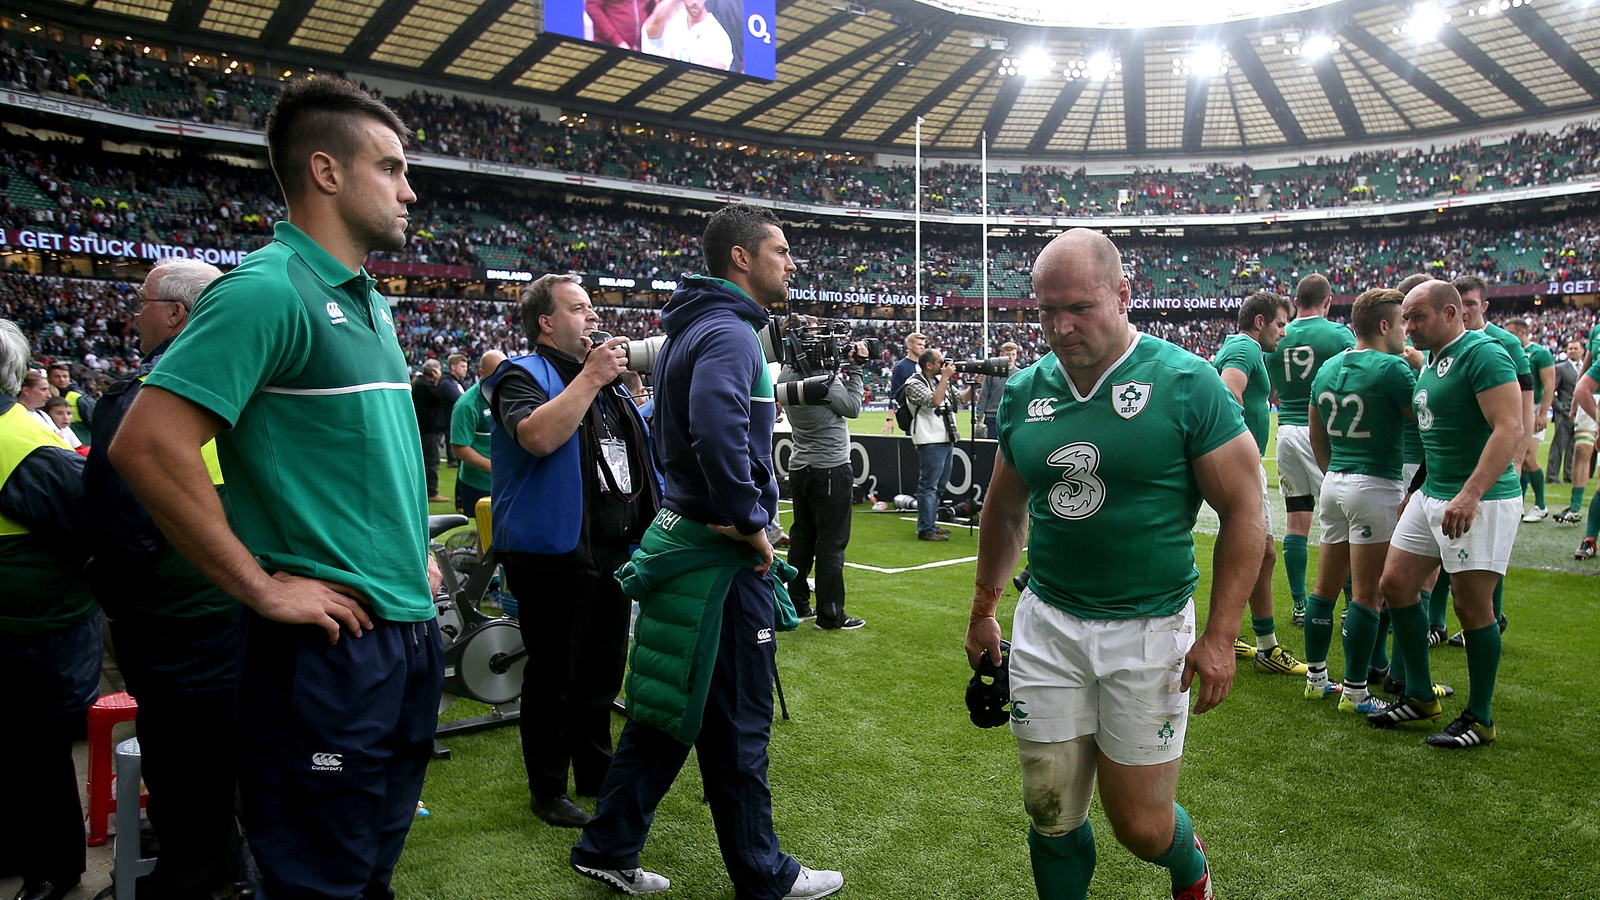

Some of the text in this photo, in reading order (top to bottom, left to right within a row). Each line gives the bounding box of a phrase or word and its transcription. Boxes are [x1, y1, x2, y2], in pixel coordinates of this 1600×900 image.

[19, 231, 64, 250] GET
[69, 235, 138, 258] STUCK
[141, 243, 188, 260] INTO
[789, 288, 817, 301] TUCK
[819, 290, 843, 303] INTO
[844, 292, 877, 304] SOME
[1562, 279, 1595, 294] GET
[1128, 298, 1151, 309] UCK
[1153, 298, 1181, 309] INTO
[1184, 298, 1217, 309] SOME
[1283, 345, 1315, 382] 19
[1120, 406, 1138, 414] IRFU
[1318, 391, 1372, 439] 22
[1414, 389, 1435, 431] 3
[774, 438, 796, 476] O
[1046, 440, 1106, 520] 3
